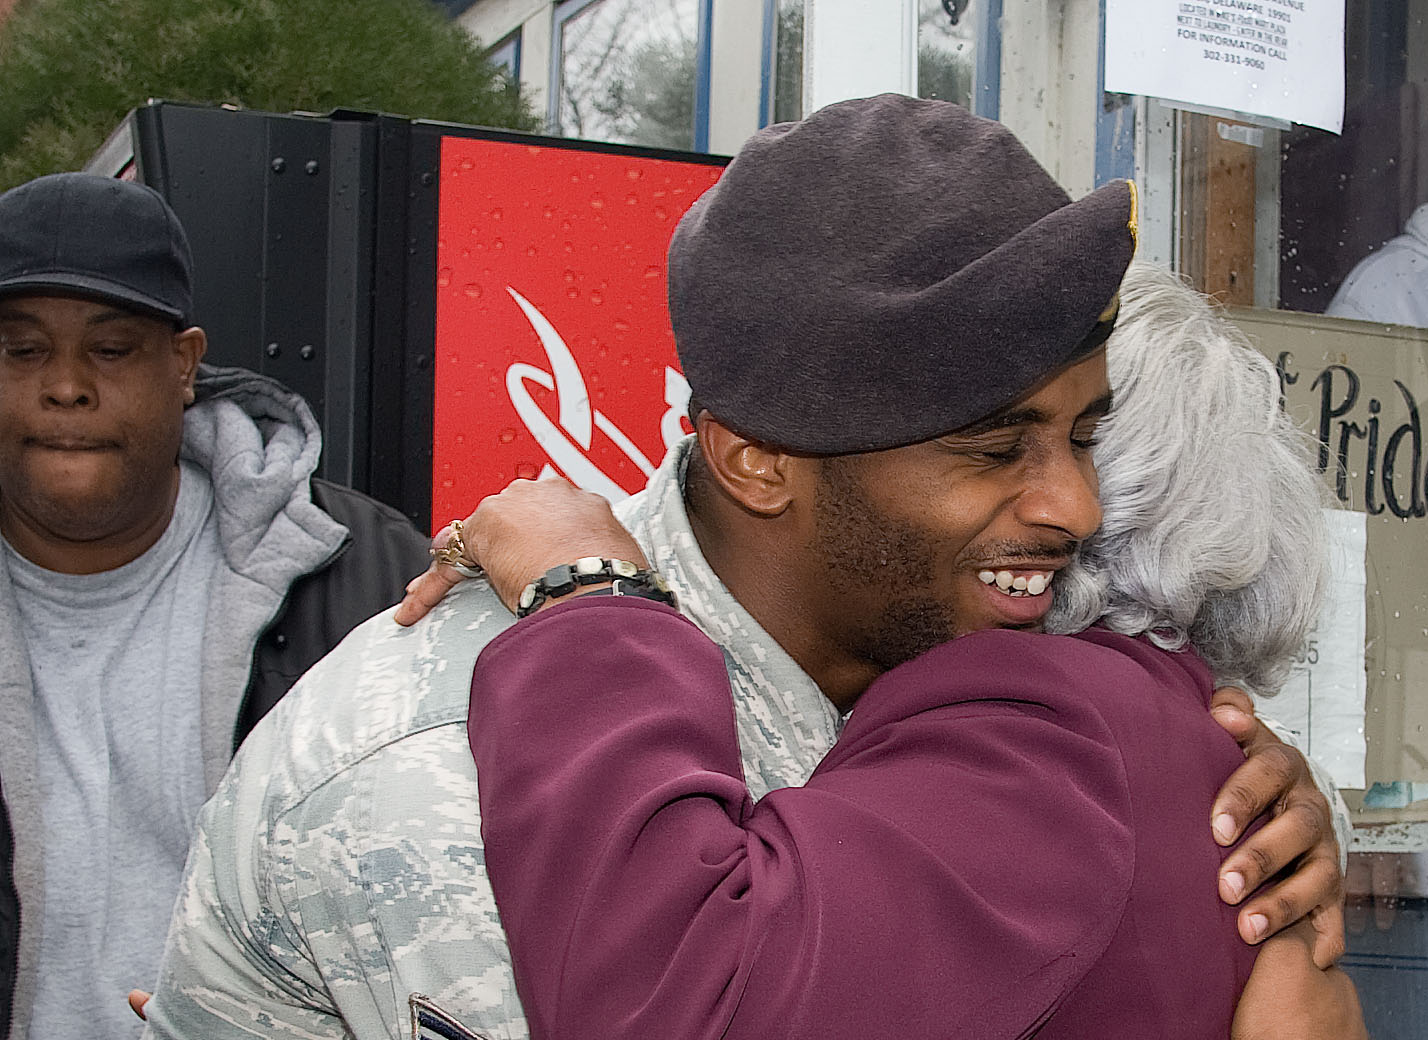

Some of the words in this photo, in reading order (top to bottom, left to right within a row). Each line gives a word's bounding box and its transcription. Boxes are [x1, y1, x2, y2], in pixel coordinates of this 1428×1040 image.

[1177, 28, 1197, 41] FOR
[1199, 33, 1266, 55] INFORMATION
[1268, 47, 1287, 61] CALL
